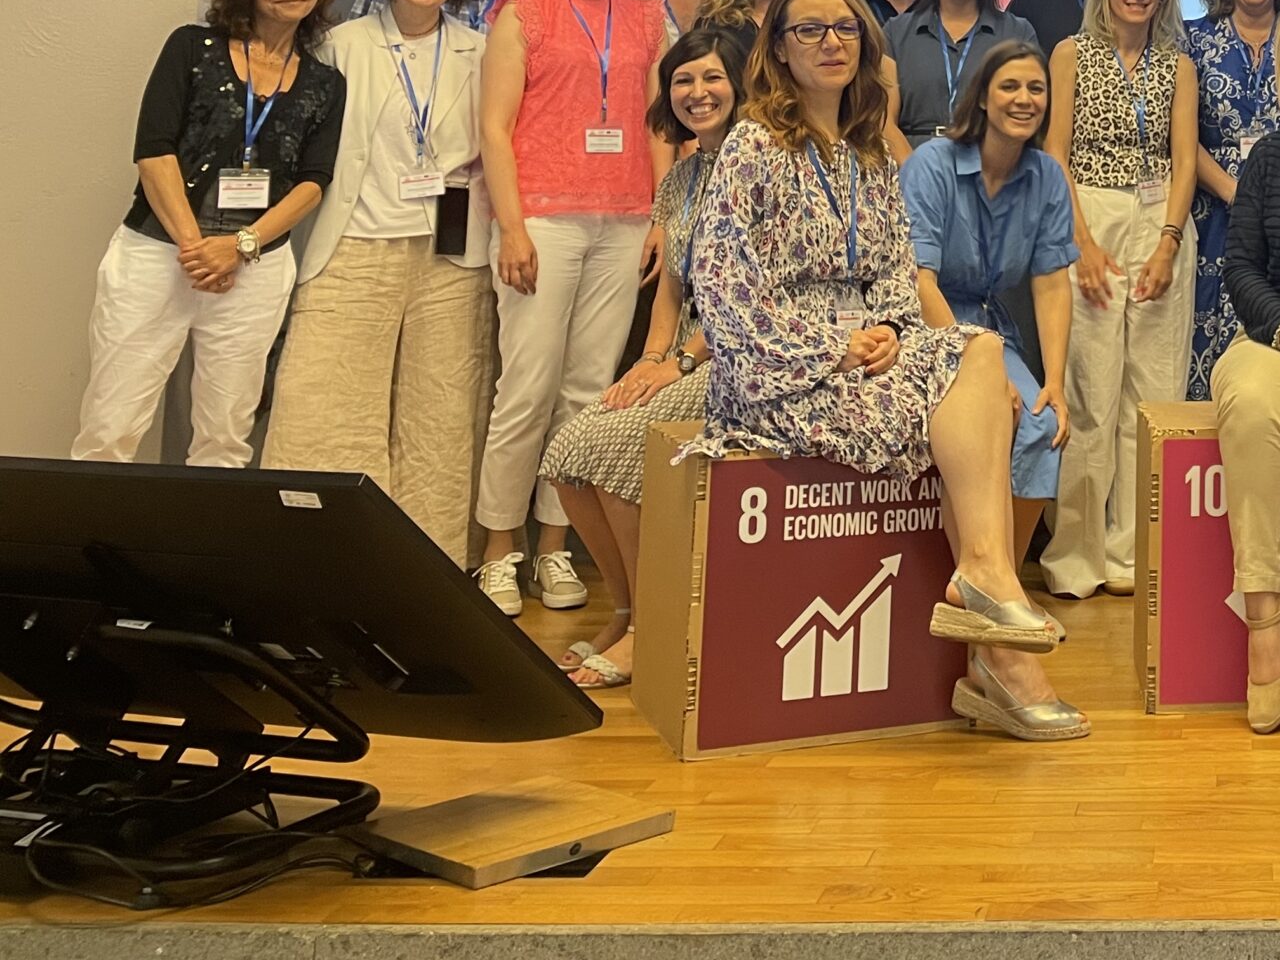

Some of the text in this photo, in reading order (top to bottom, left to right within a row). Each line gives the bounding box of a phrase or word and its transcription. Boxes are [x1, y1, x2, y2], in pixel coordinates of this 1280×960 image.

[784, 476, 942, 510] DECENT WORK AN
[1184, 464, 1228, 517] 10
[738, 486, 768, 544] 8
[783, 506, 943, 541] ECONOMIC GROWT
